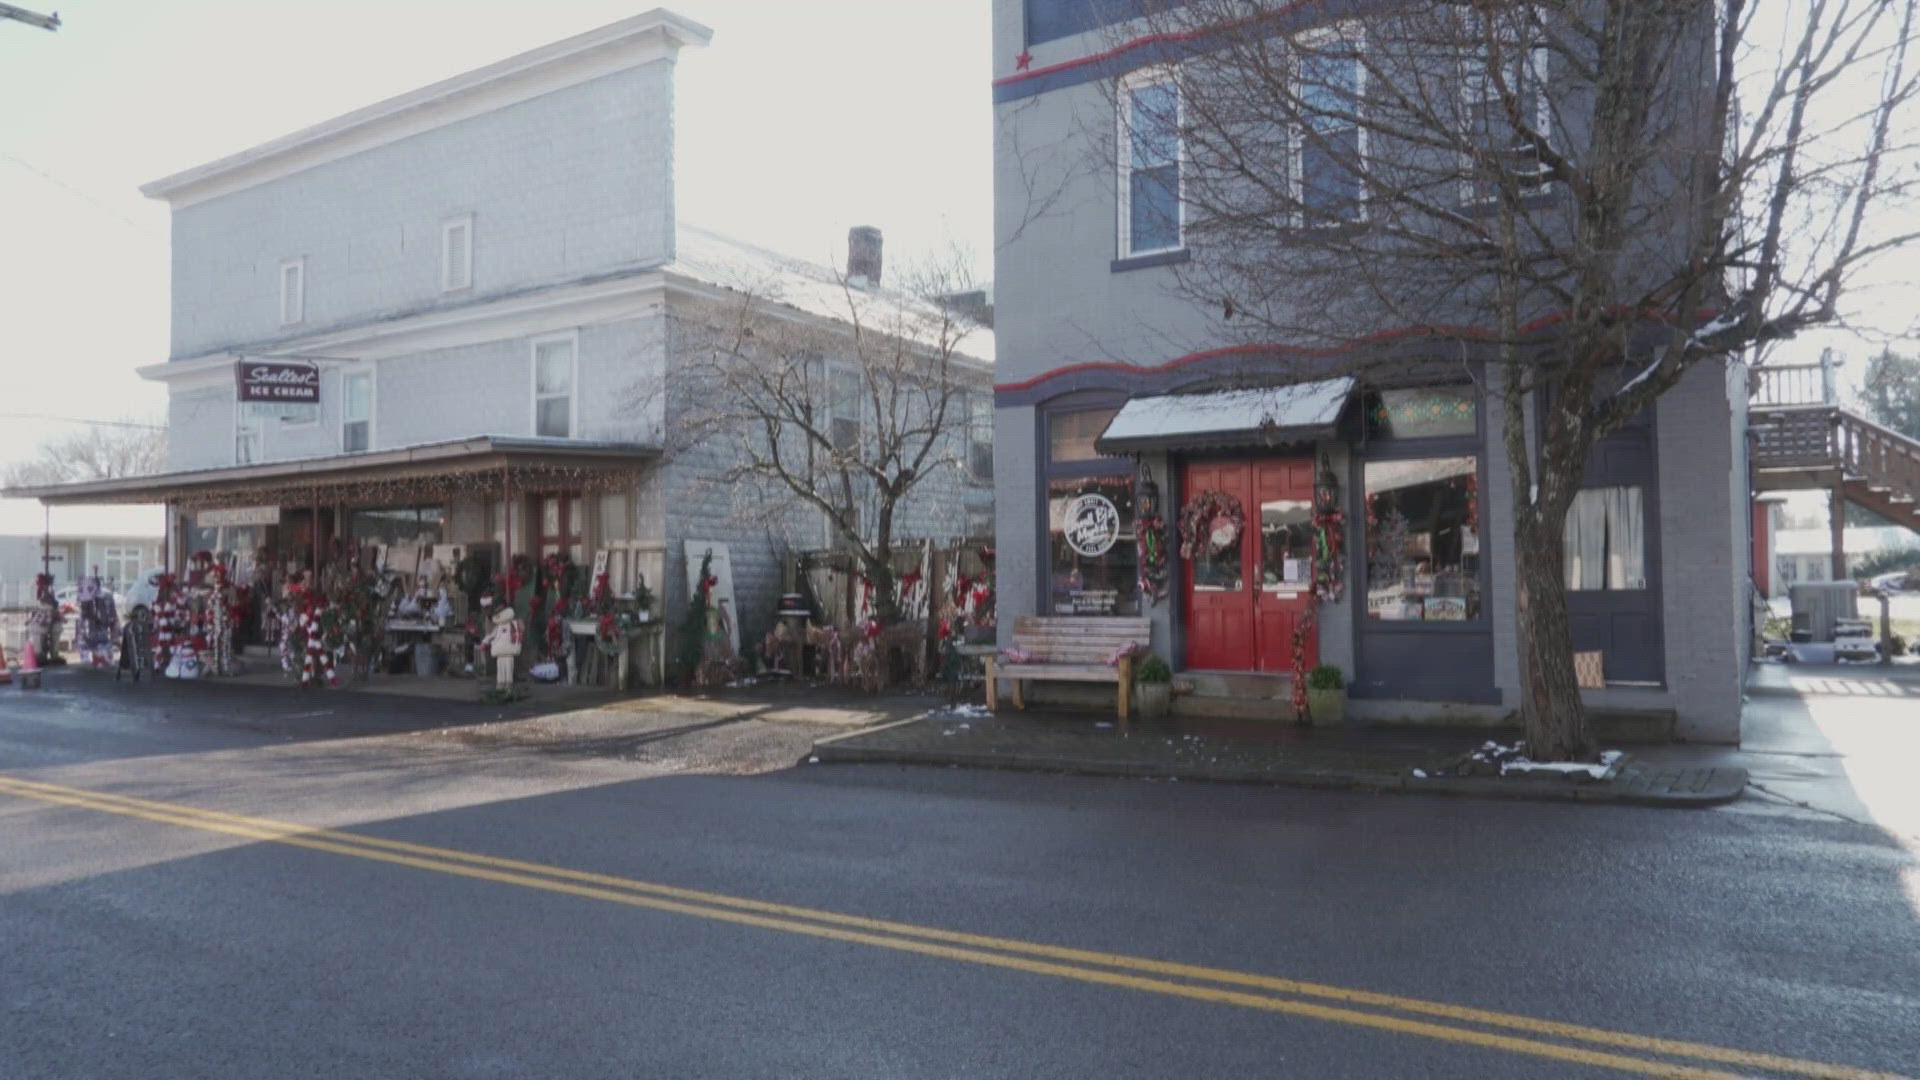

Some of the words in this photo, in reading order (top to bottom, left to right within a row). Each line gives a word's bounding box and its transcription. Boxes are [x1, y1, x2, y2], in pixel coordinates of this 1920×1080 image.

[247, 366, 318, 385] Sealtest
[250, 385, 269, 395] ICE
[274, 387, 314, 397] CREAM
